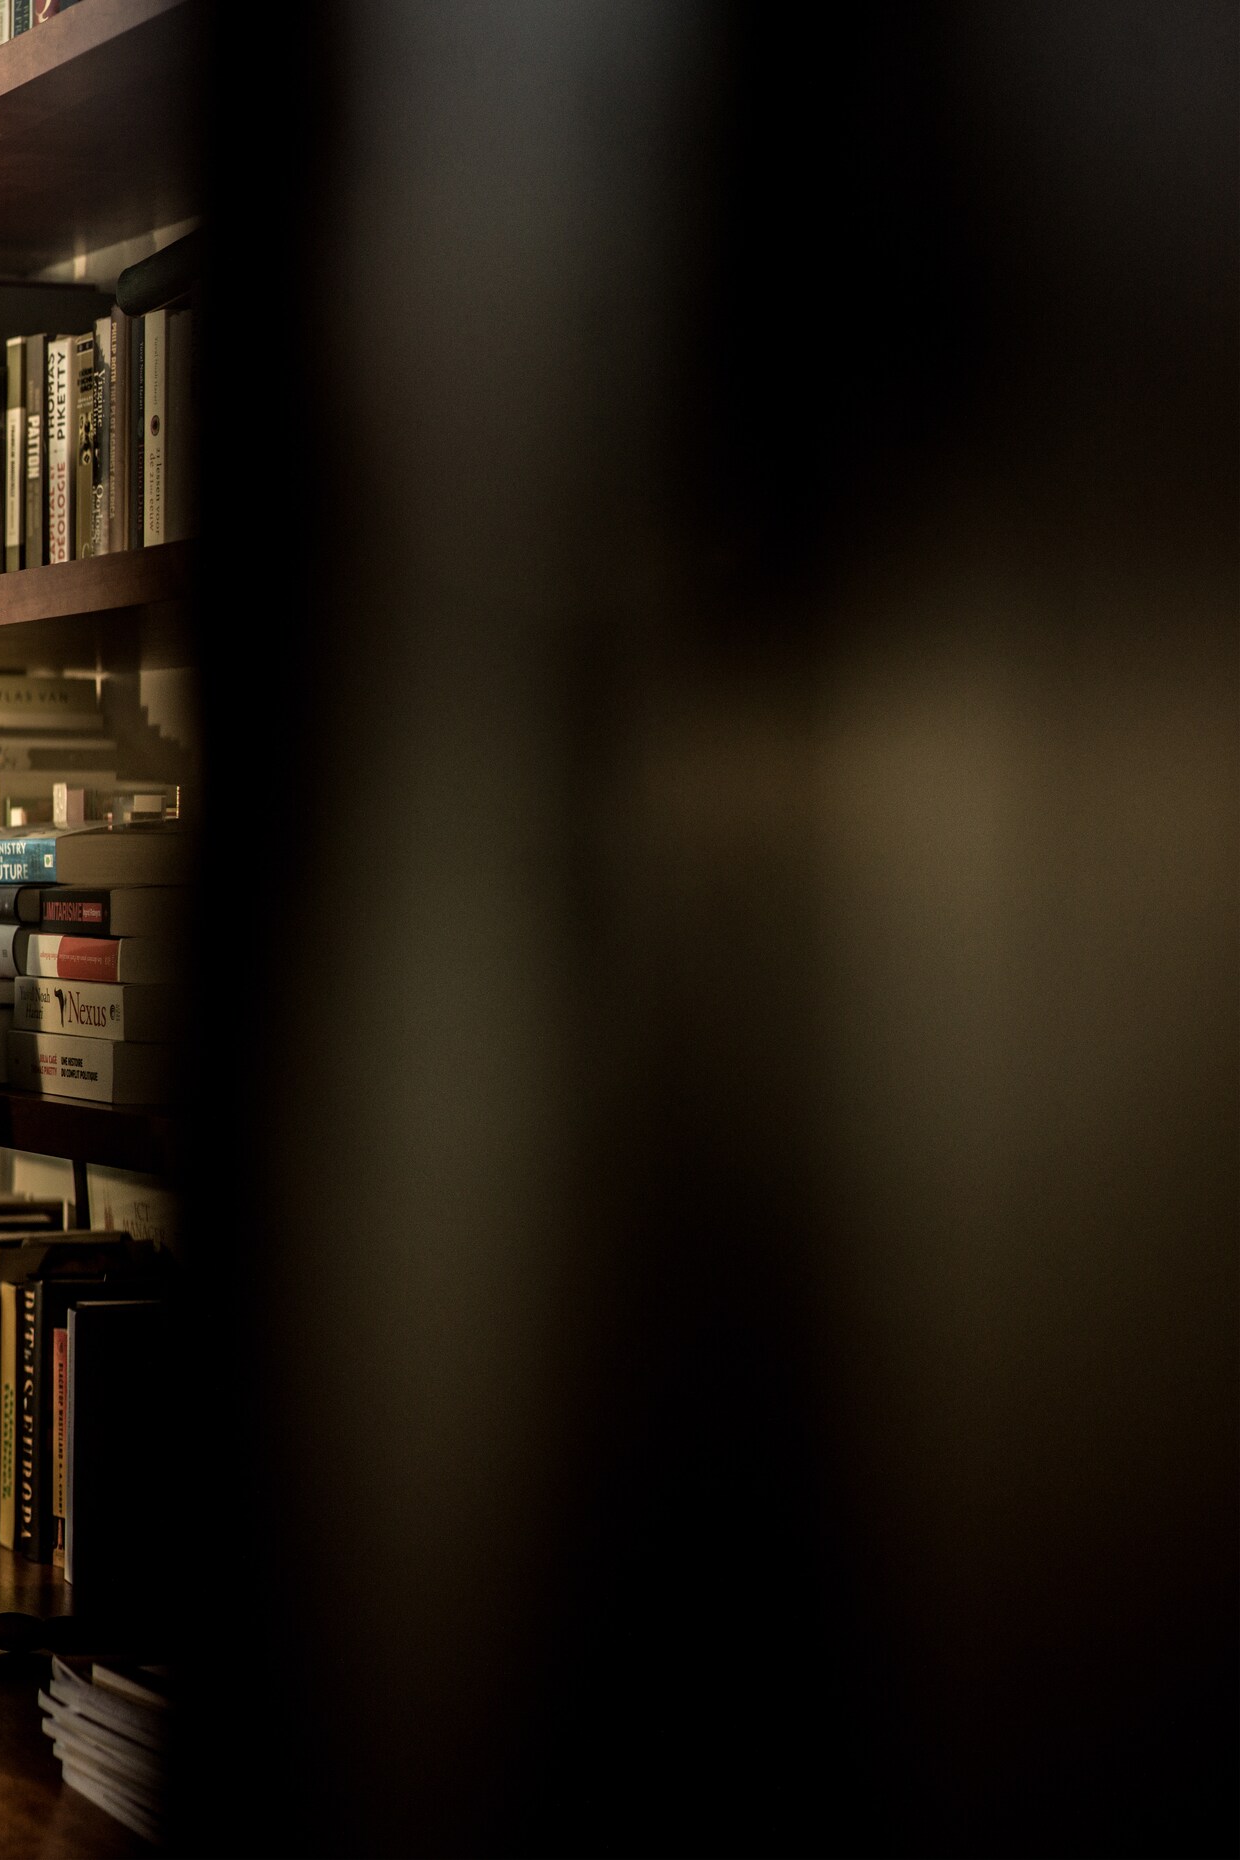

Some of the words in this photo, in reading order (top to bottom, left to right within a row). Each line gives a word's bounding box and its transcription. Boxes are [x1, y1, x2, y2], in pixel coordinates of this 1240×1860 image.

[57, 352, 65, 441] PIKETTY
[96, 368, 105, 428] Virginie
[28, 414, 40, 479] PATTON
[149, 453, 157, 469] de
[155, 462, 163, 502] lessen
[37, 691, 69, 704] VAN
[43, 901, 82, 922] LIMITARISME
[35, 987, 51, 1003] Noah
[68, 991, 107, 1027] Nexus
[80, 1070, 99, 1082] POLITIQUE
